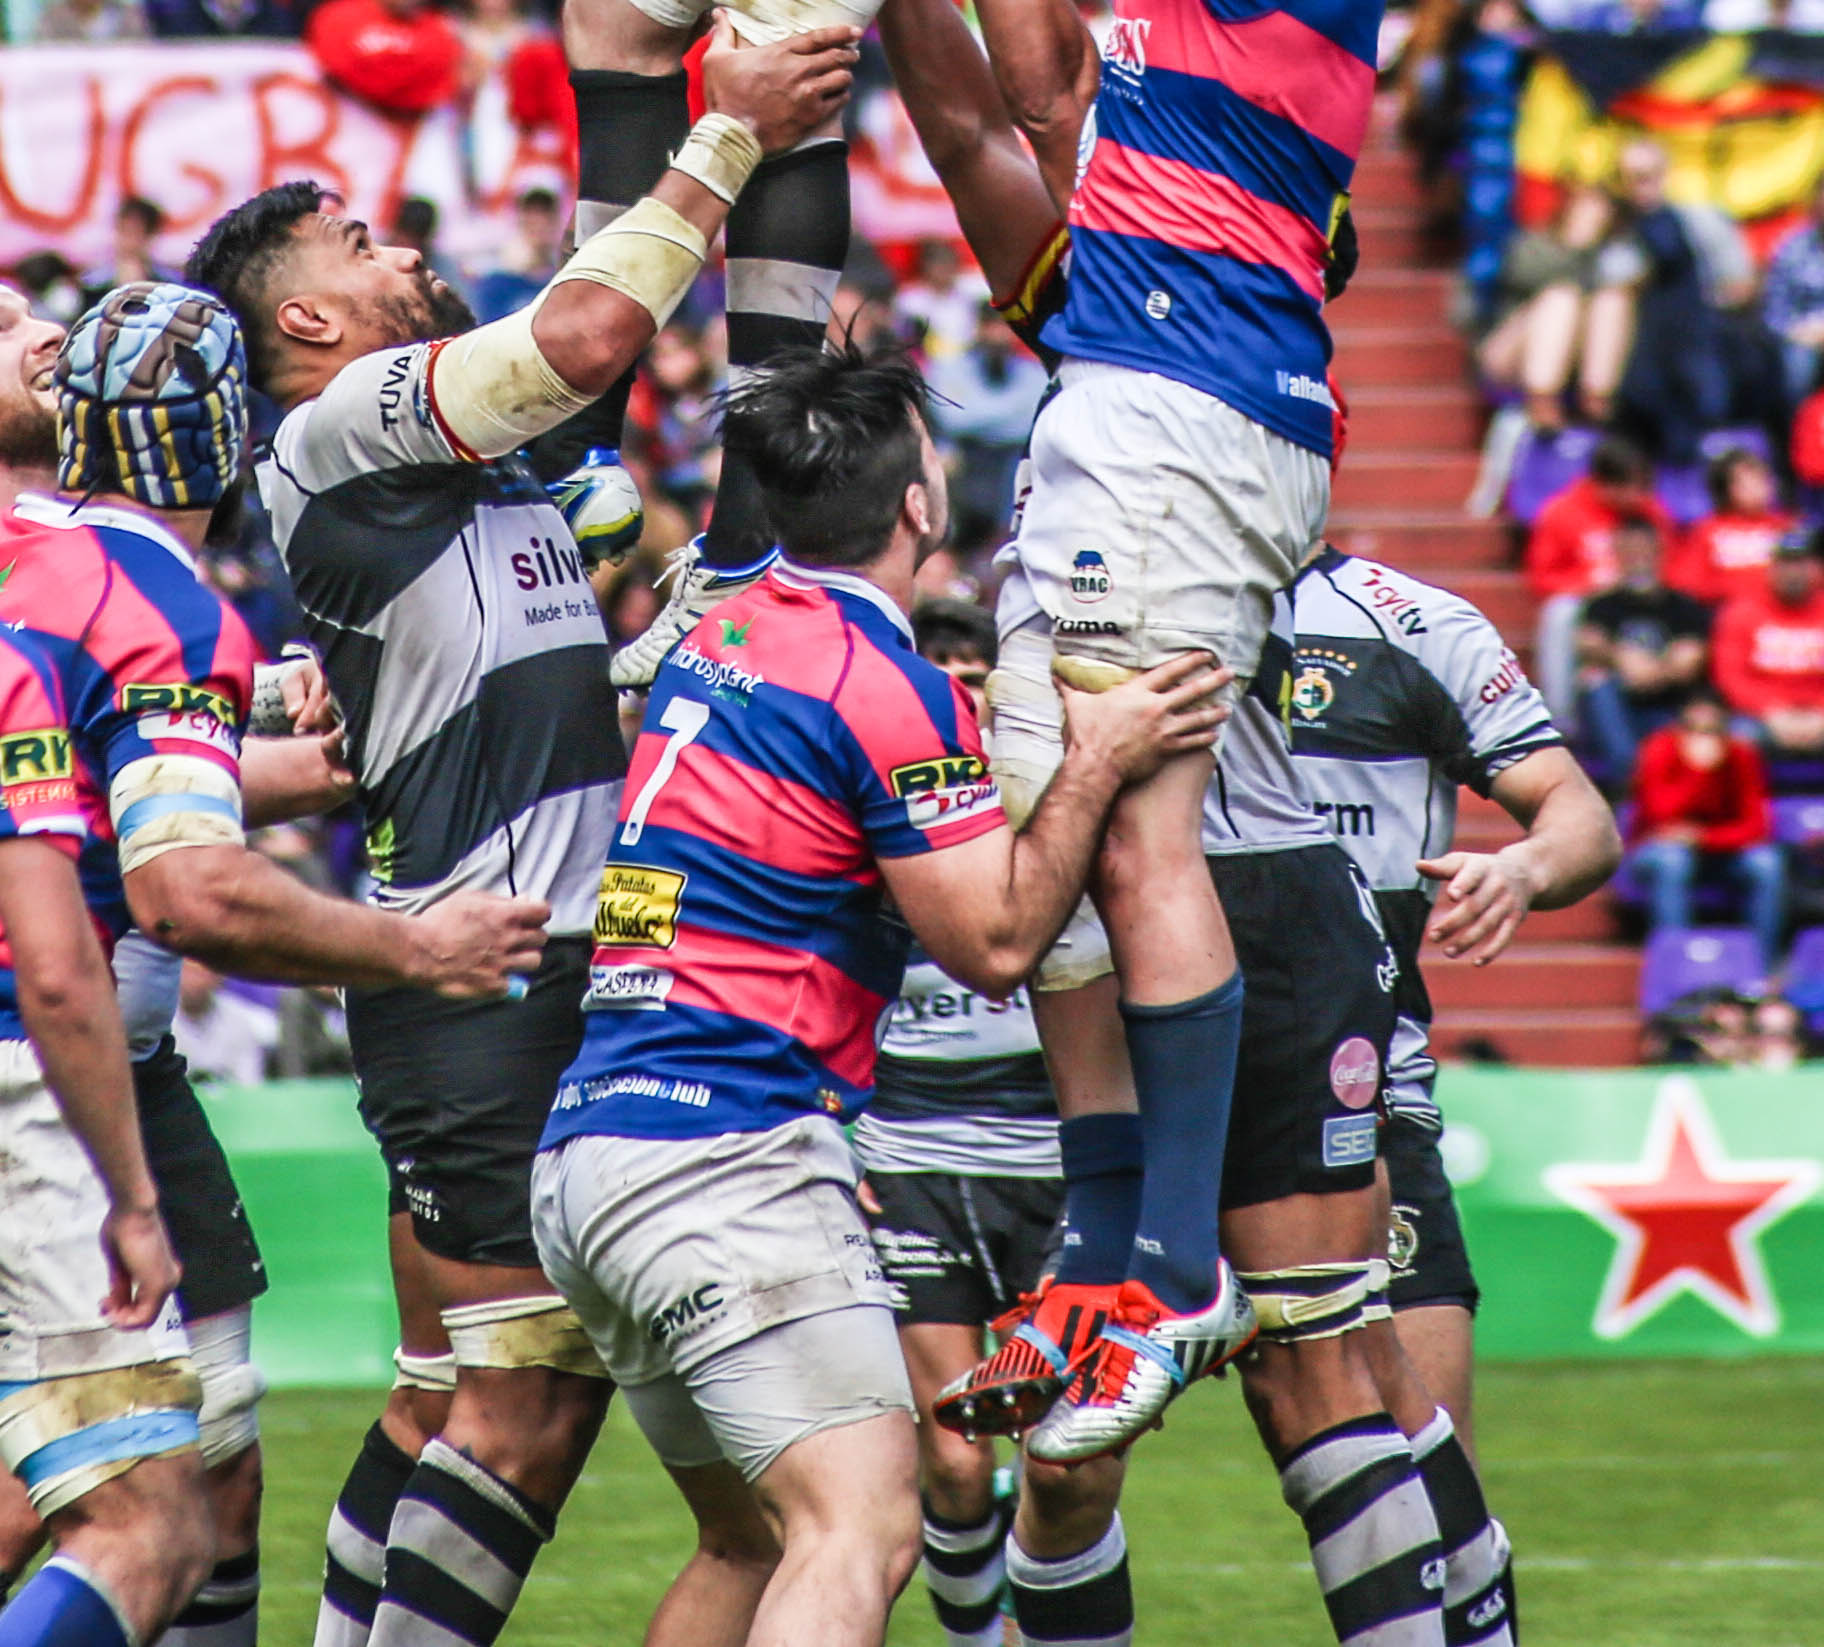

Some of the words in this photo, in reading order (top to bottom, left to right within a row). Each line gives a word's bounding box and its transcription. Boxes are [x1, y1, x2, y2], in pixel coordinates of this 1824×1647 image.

[524, 606, 562, 627] Made
[564, 599, 583, 618] for
[667, 640, 766, 694] hidrosyplant
[619, 696, 711, 847] 7
